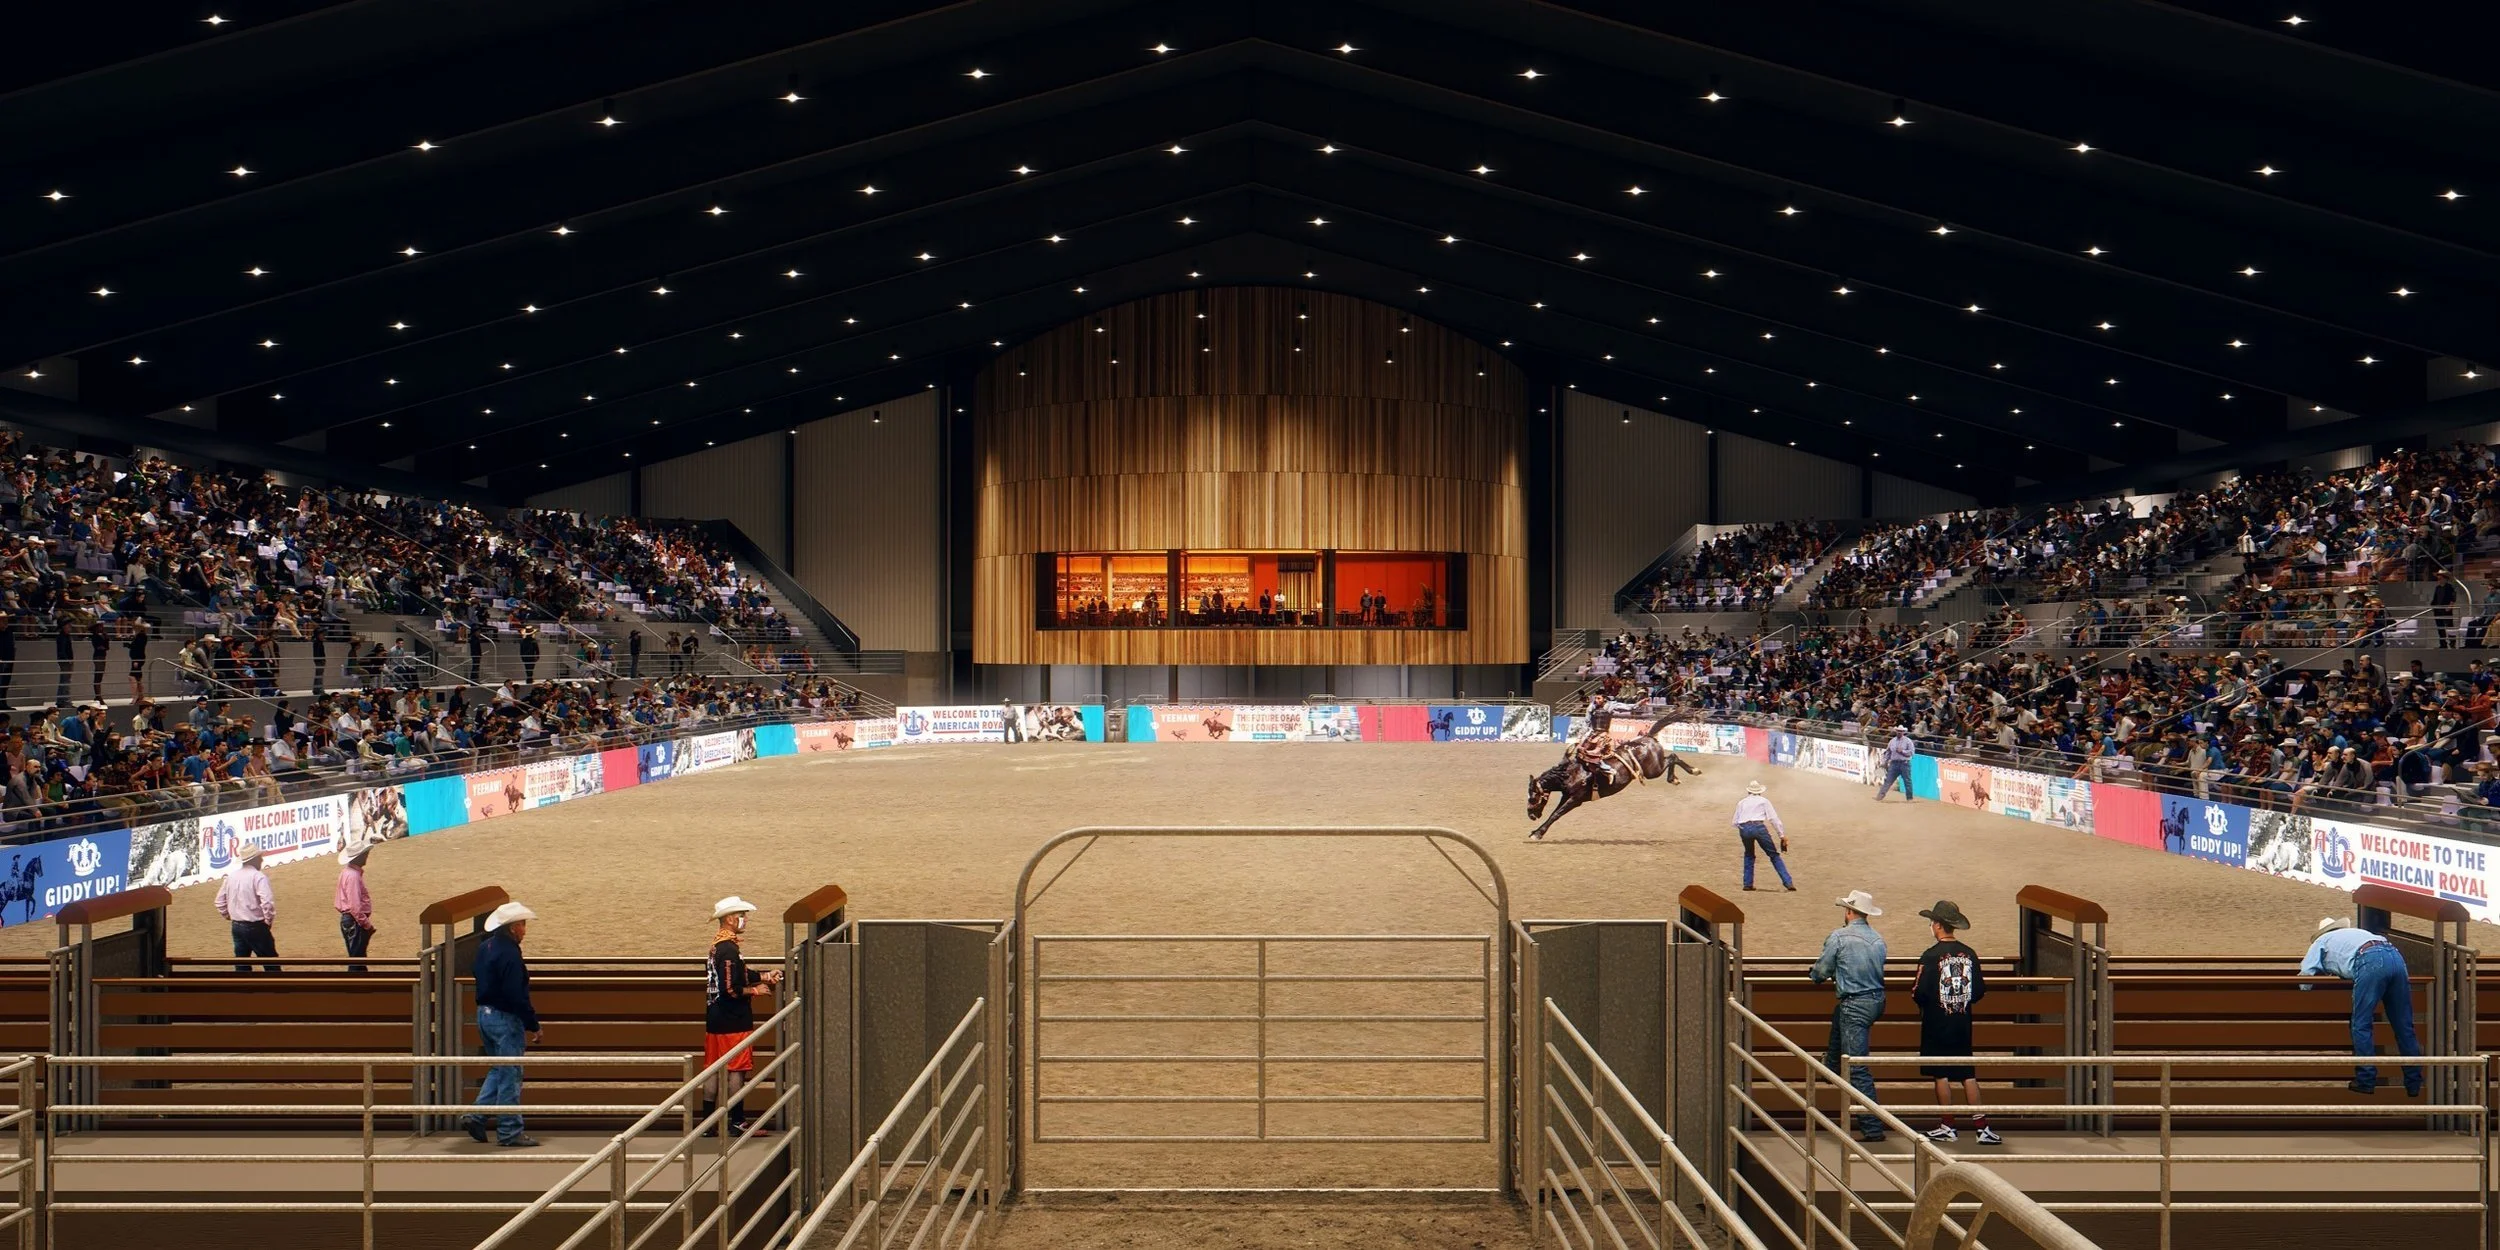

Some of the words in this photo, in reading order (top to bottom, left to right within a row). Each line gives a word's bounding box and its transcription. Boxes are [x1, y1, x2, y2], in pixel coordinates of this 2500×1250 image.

[933, 710, 977, 718] WELCOME
[980, 710, 989, 718] TO
[992, 710, 1002, 718] TH
[1160, 713, 1200, 723] YEEHAW!
[933, 721, 979, 730] AMERICAN
[982, 721, 1003, 729] ROYA
[1455, 727, 1481, 735] GIDDY
[1483, 727, 1497, 735] UP!
[473, 780, 502, 796] YEEHAW!
[244, 808, 296, 832] WELCOME
[298, 807, 309, 822] TO
[312, 803, 330, 819] THE
[301, 823, 331, 842] ROYAL
[2191, 835, 2221, 854] GIDDY
[2224, 841, 2241, 859] UP!
[2360, 833, 2430, 862] WELCOME
[2434, 846, 2452, 865] TO
[2456, 849, 2486, 871] THE
[2360, 857, 2434, 888] AMERICAN
[2440, 872, 2488, 898] ROYAL
[45, 880, 92, 907] GIDDY
[96, 875, 120, 896] UP!
